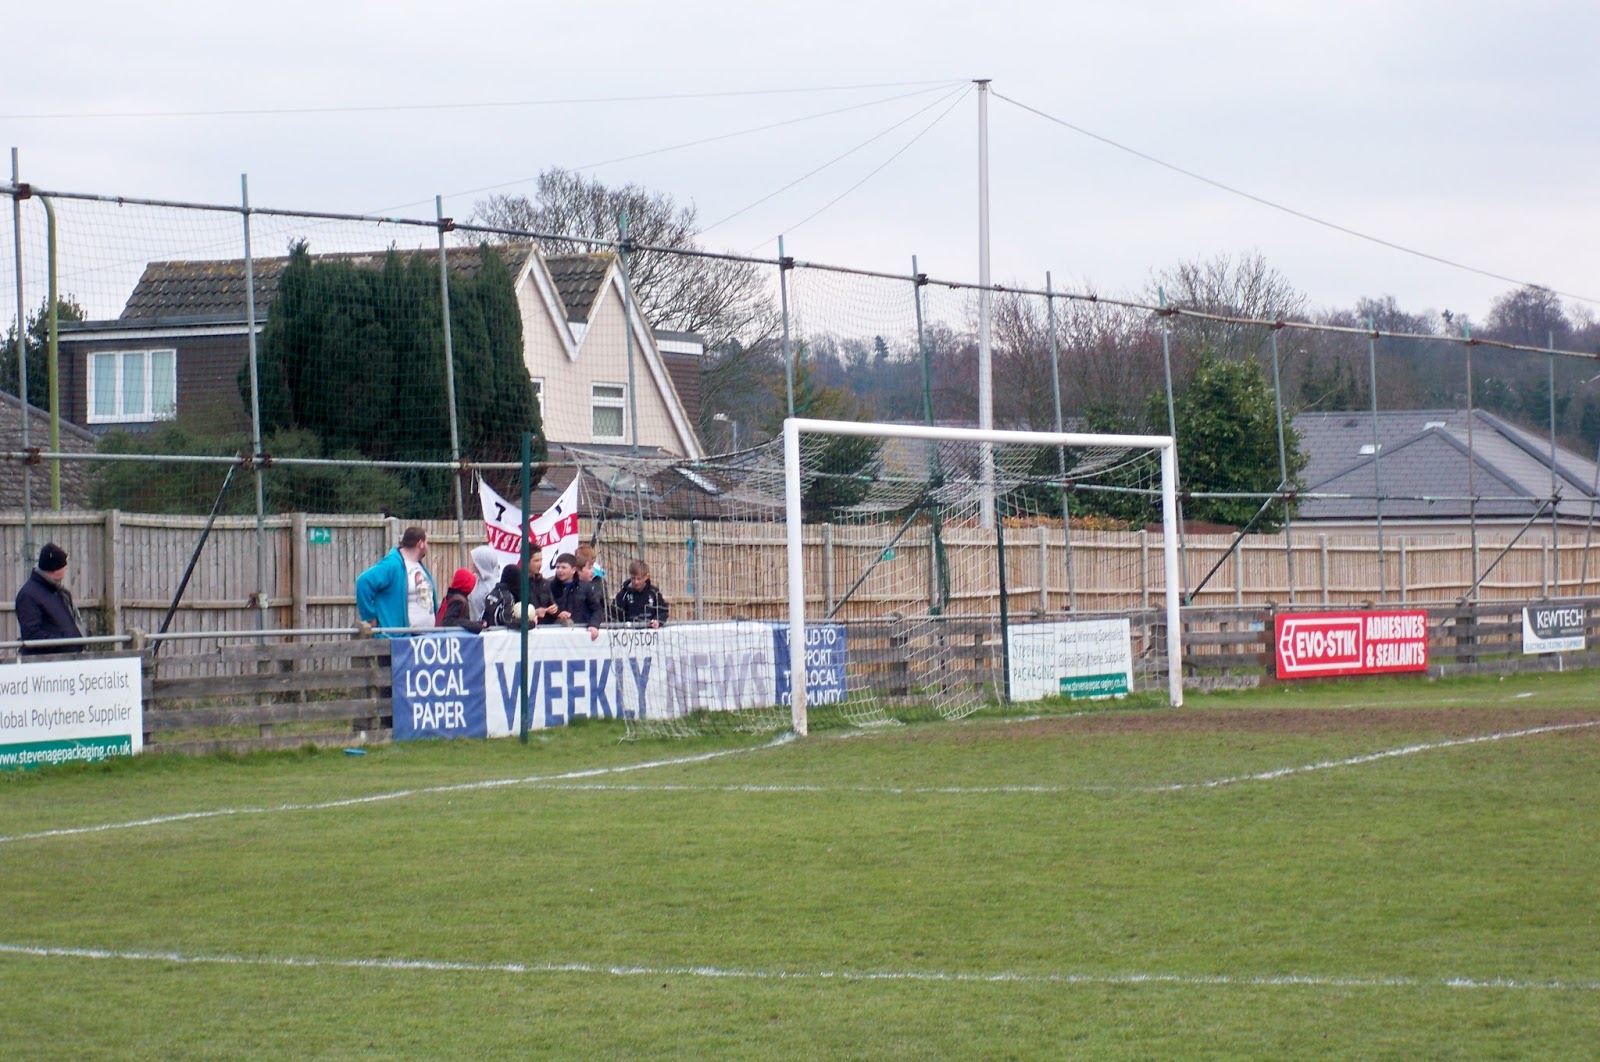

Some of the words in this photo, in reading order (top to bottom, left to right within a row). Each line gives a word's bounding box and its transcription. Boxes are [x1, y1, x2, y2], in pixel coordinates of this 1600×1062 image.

[1366, 615, 1425, 639] ADHESIVES
[1537, 609, 1583, 628] KEWTECH
[786, 628, 820, 646] PUD
[821, 628, 836, 645] TO
[410, 638, 463, 665] YOUR
[803, 649, 832, 667] PORT
[1366, 644, 1375, 668] &
[1376, 642, 1425, 667] SEALANTS
[0, 676, 28, 695] ward
[32, 675, 75, 696] Winning
[79, 671, 129, 695] Specialist
[406, 669, 469, 697] LOCAL
[805, 669, 838, 687] LOCAL
[1013, 665, 1055, 682] PACKAGING
[495, 656, 652, 732] WEEKLY
[665, 651, 768, 719] NEWS
[0, 709, 27, 730] lobal
[32, 707, 85, 730] Polythene
[88, 704, 132, 727] Supplier
[413, 701, 467, 730] PAPER
